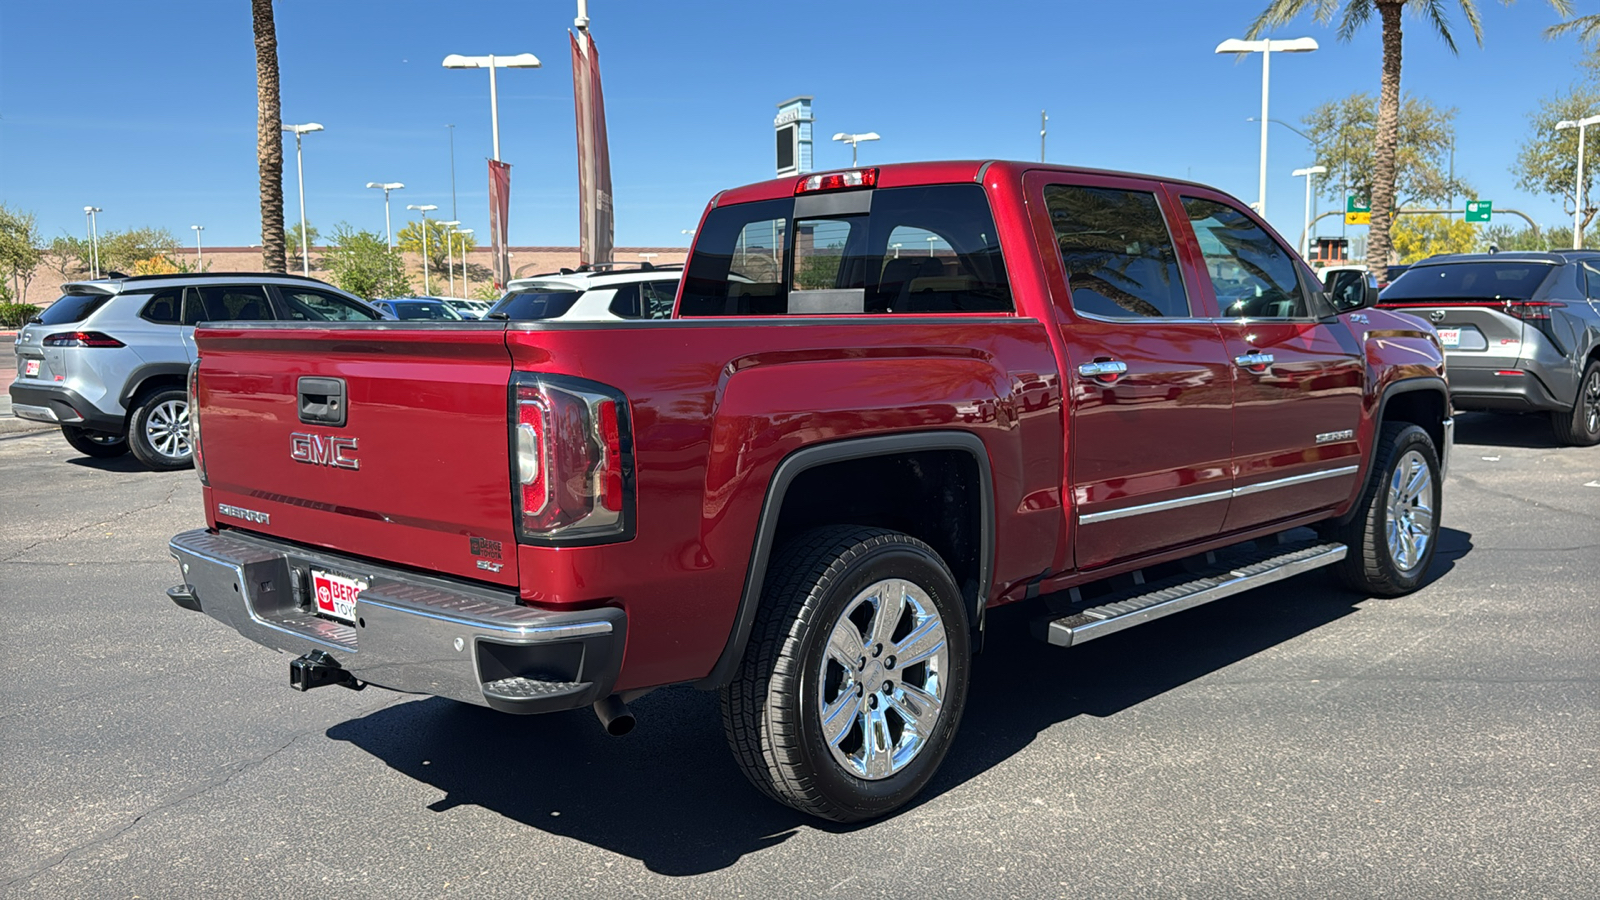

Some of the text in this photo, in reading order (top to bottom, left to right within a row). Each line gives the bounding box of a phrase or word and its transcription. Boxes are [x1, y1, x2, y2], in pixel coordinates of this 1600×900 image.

[1315, 429, 1353, 444] SIERRA
[290, 432, 359, 470] GMC
[218, 502, 270, 525] SIERRA
[479, 537, 502, 551] BERGE
[480, 549, 503, 560] TOYOTA
[476, 560, 504, 573] SLT
[332, 581, 363, 605] BERG
[334, 601, 357, 617] TOY
